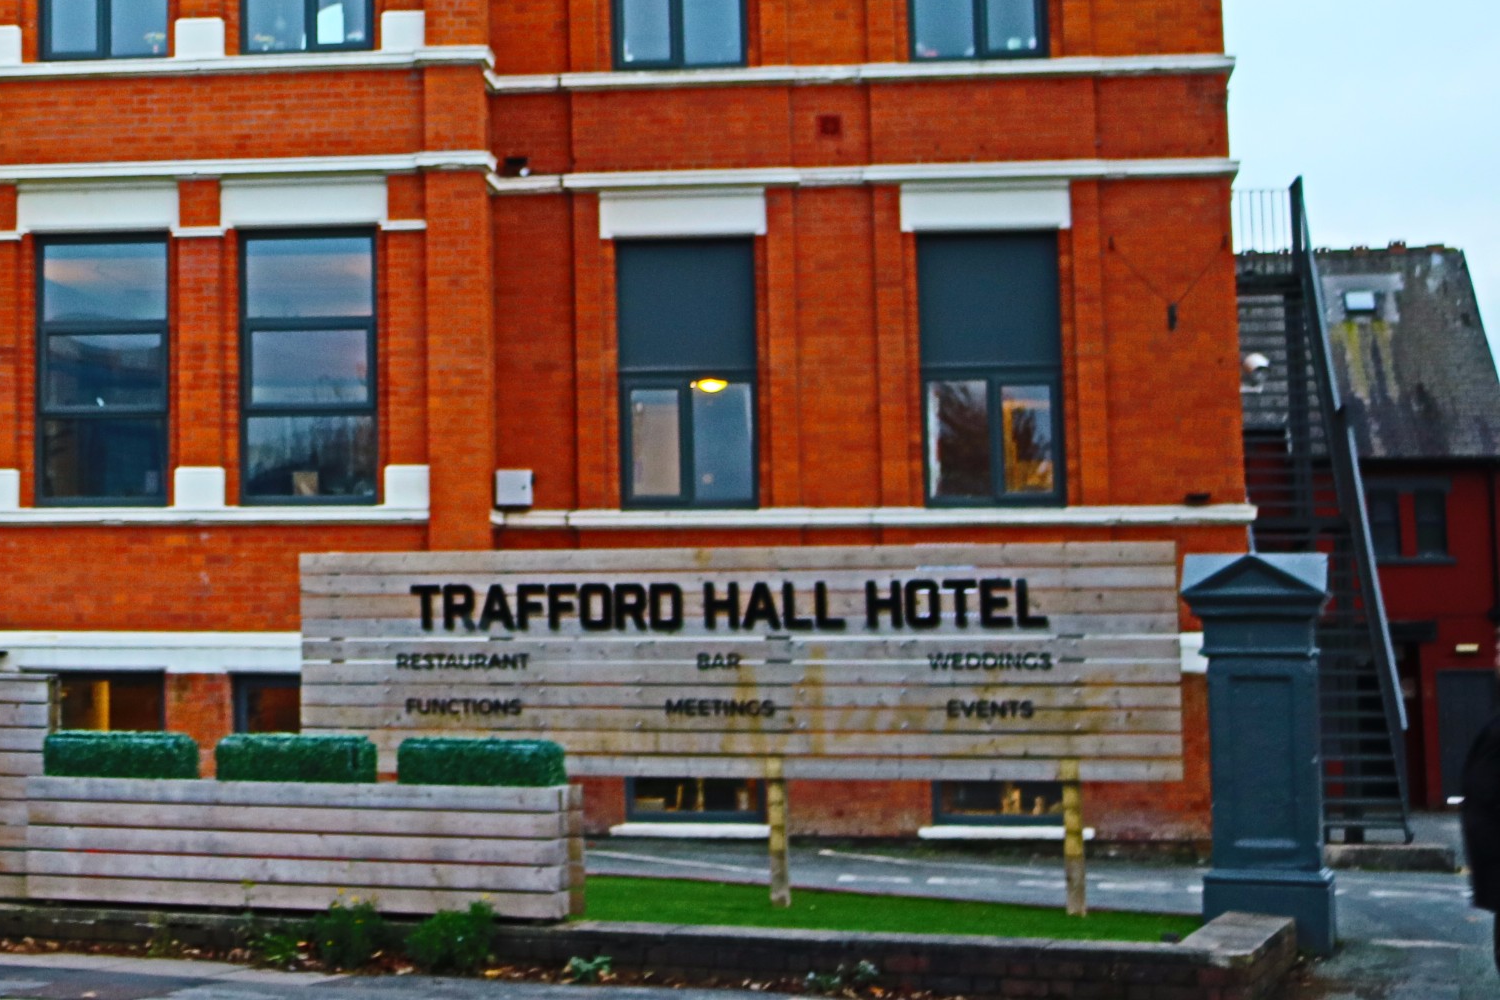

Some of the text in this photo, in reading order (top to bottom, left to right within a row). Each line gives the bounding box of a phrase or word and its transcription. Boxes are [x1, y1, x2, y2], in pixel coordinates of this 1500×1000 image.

[409, 578, 1050, 632] TRAFFORD HALL HOTEL
[396, 653, 530, 670] RESTAURANT
[697, 652, 741, 670] BAR
[927, 652, 1054, 671] WEDDINGS
[405, 698, 522, 716] FUNCTIONS
[665, 698, 776, 717] MEETINGS
[946, 699, 1034, 718] EVENTS
